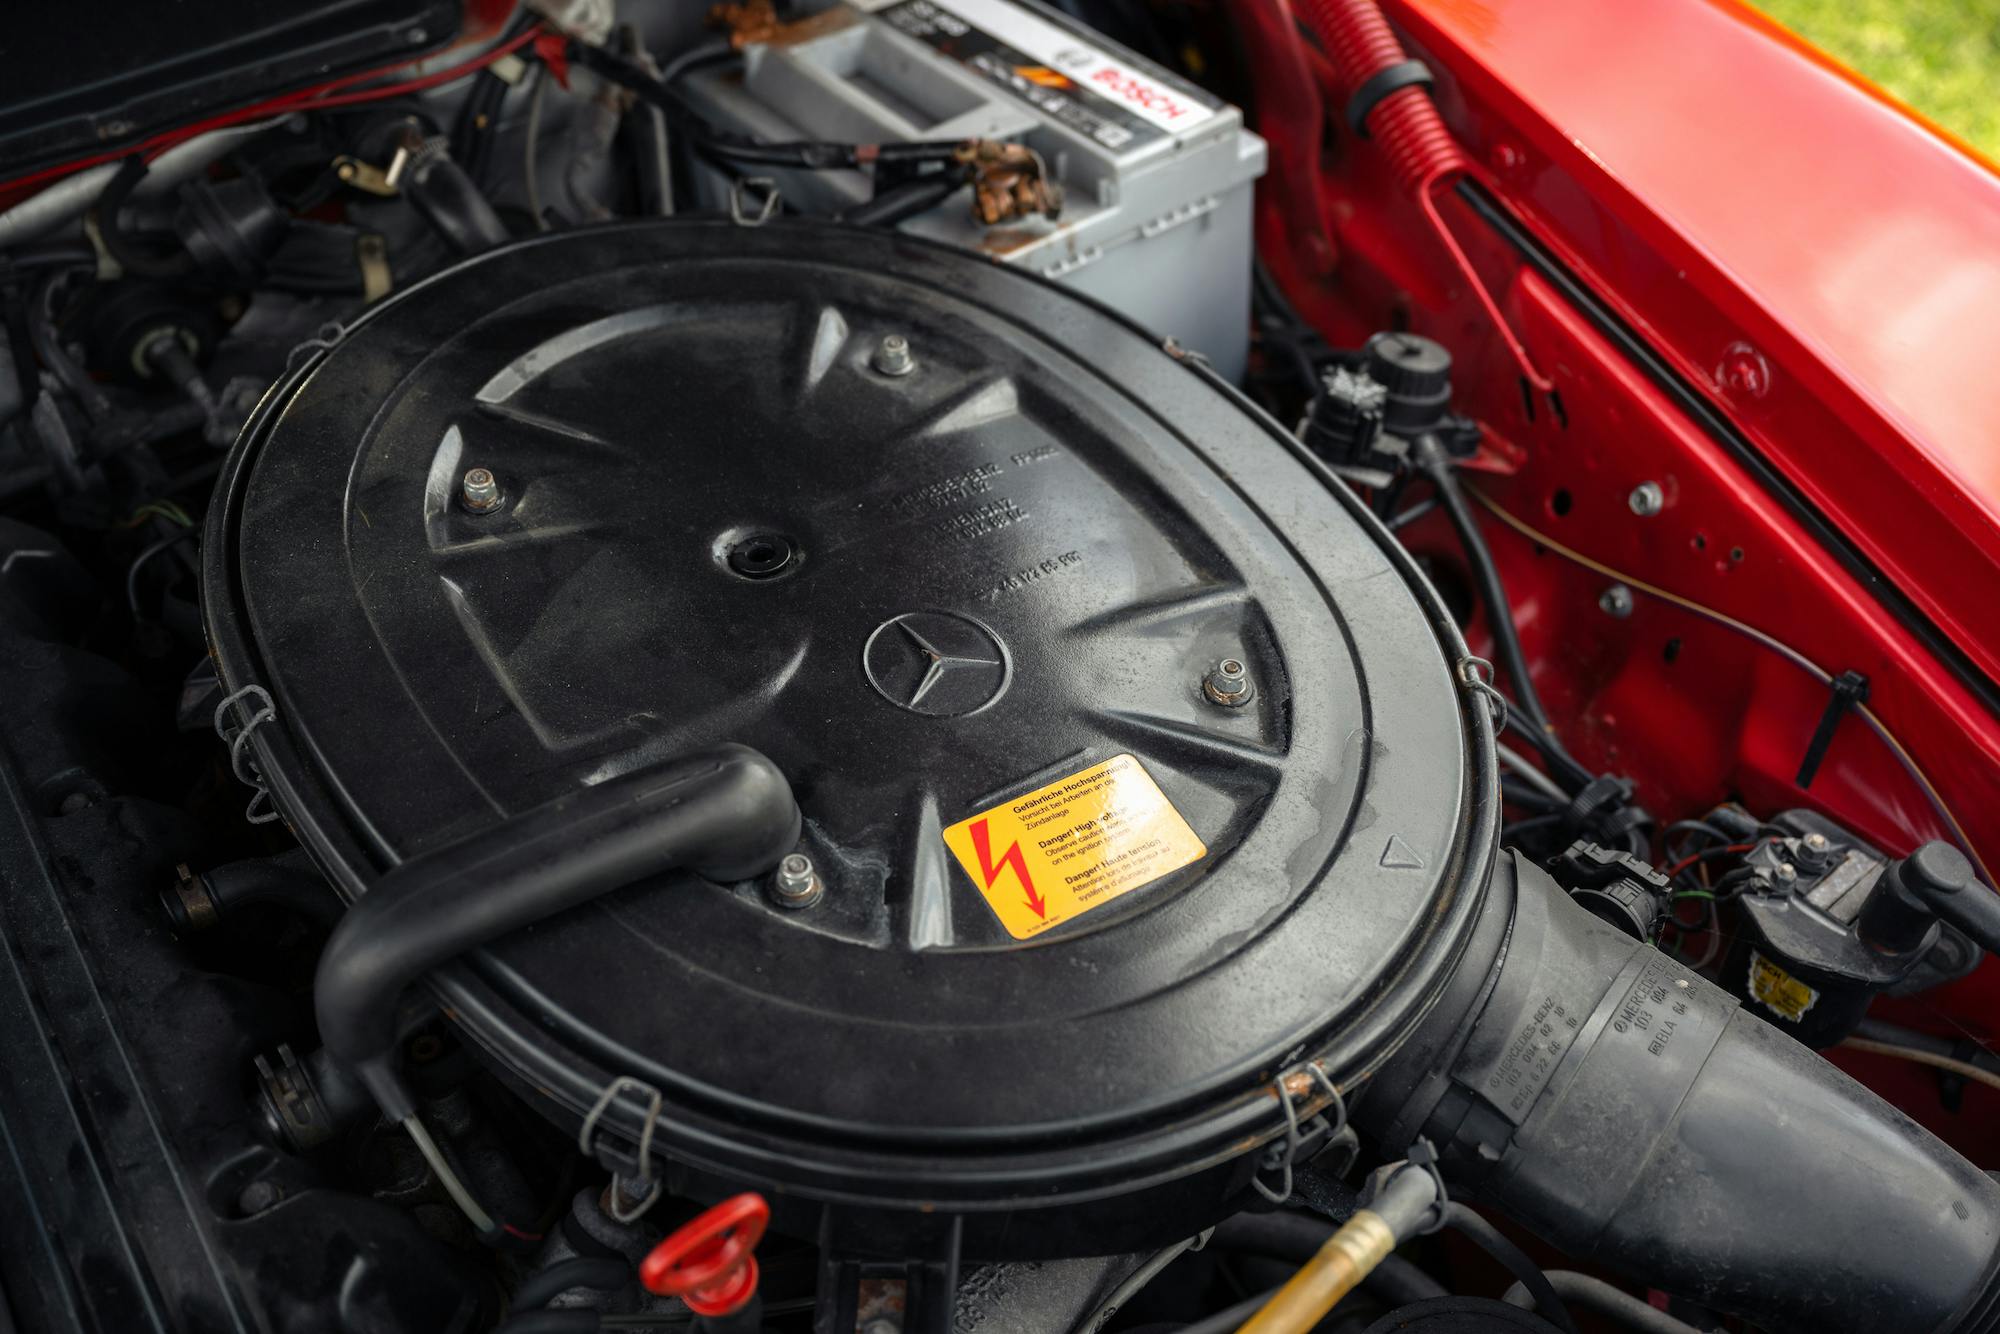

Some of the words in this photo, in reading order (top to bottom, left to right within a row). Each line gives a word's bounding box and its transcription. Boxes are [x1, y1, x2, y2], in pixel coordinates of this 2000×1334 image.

[1091, 68, 1188, 119] BOSCH
[1013, 788, 1064, 814] Gefährliche
[1063, 759, 1129, 793] Hochspannung!
[1018, 806, 1049, 822] Vorsicht
[1050, 801, 1062, 810] bei
[1063, 788, 1093, 804] Arbeiten
[1094, 783, 1104, 792] an
[1025, 808, 1070, 831] Zündanlage
[1038, 829, 1075, 849] Danger!
[1074, 819, 1097, 834] High
[1045, 839, 1078, 857] Observe
[1078, 827, 1105, 843] caution
[1052, 858, 1062, 866] on
[1063, 852, 1076, 862] the
[1076, 840, 1103, 855] ignition
[1064, 864, 1100, 885] Danger!
[1101, 853, 1128, 868] Haute
[1128, 838, 1161, 856] tension
[1072, 873, 1105, 893] Attention
[1106, 867, 1120, 878] lors
[1634, 1010, 1652, 1030] 103
[1655, 1020, 1677, 1043] BLA
[1495, 996, 1555, 1080] MERCEDES-BENZ
